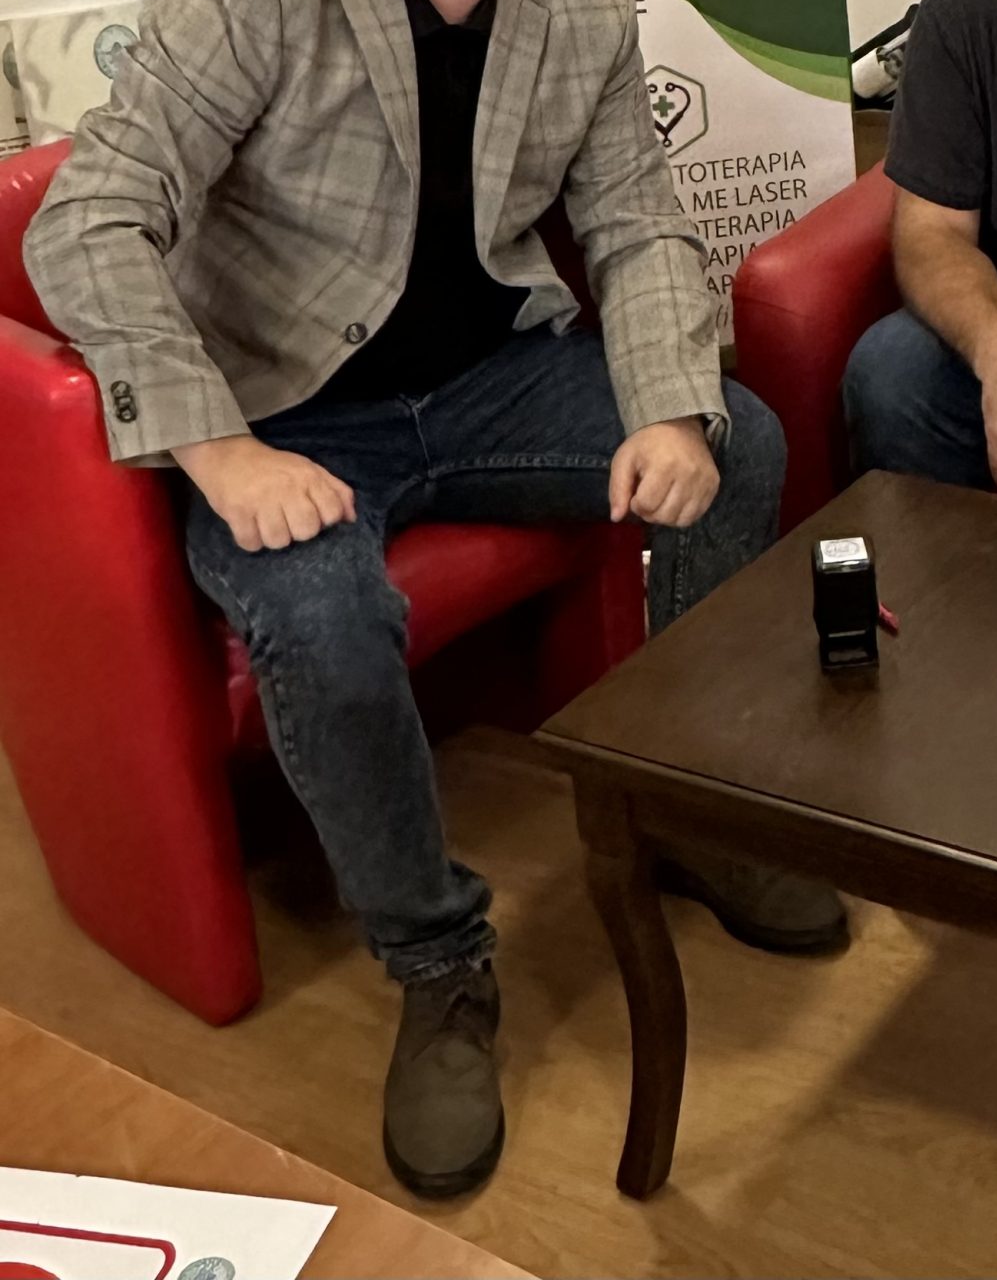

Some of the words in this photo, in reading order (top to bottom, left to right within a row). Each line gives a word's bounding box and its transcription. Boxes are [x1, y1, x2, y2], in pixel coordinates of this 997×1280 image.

[692, 188, 729, 213] ME
[734, 178, 808, 207] LASER
[692, 208, 797, 240] TERAPIA
